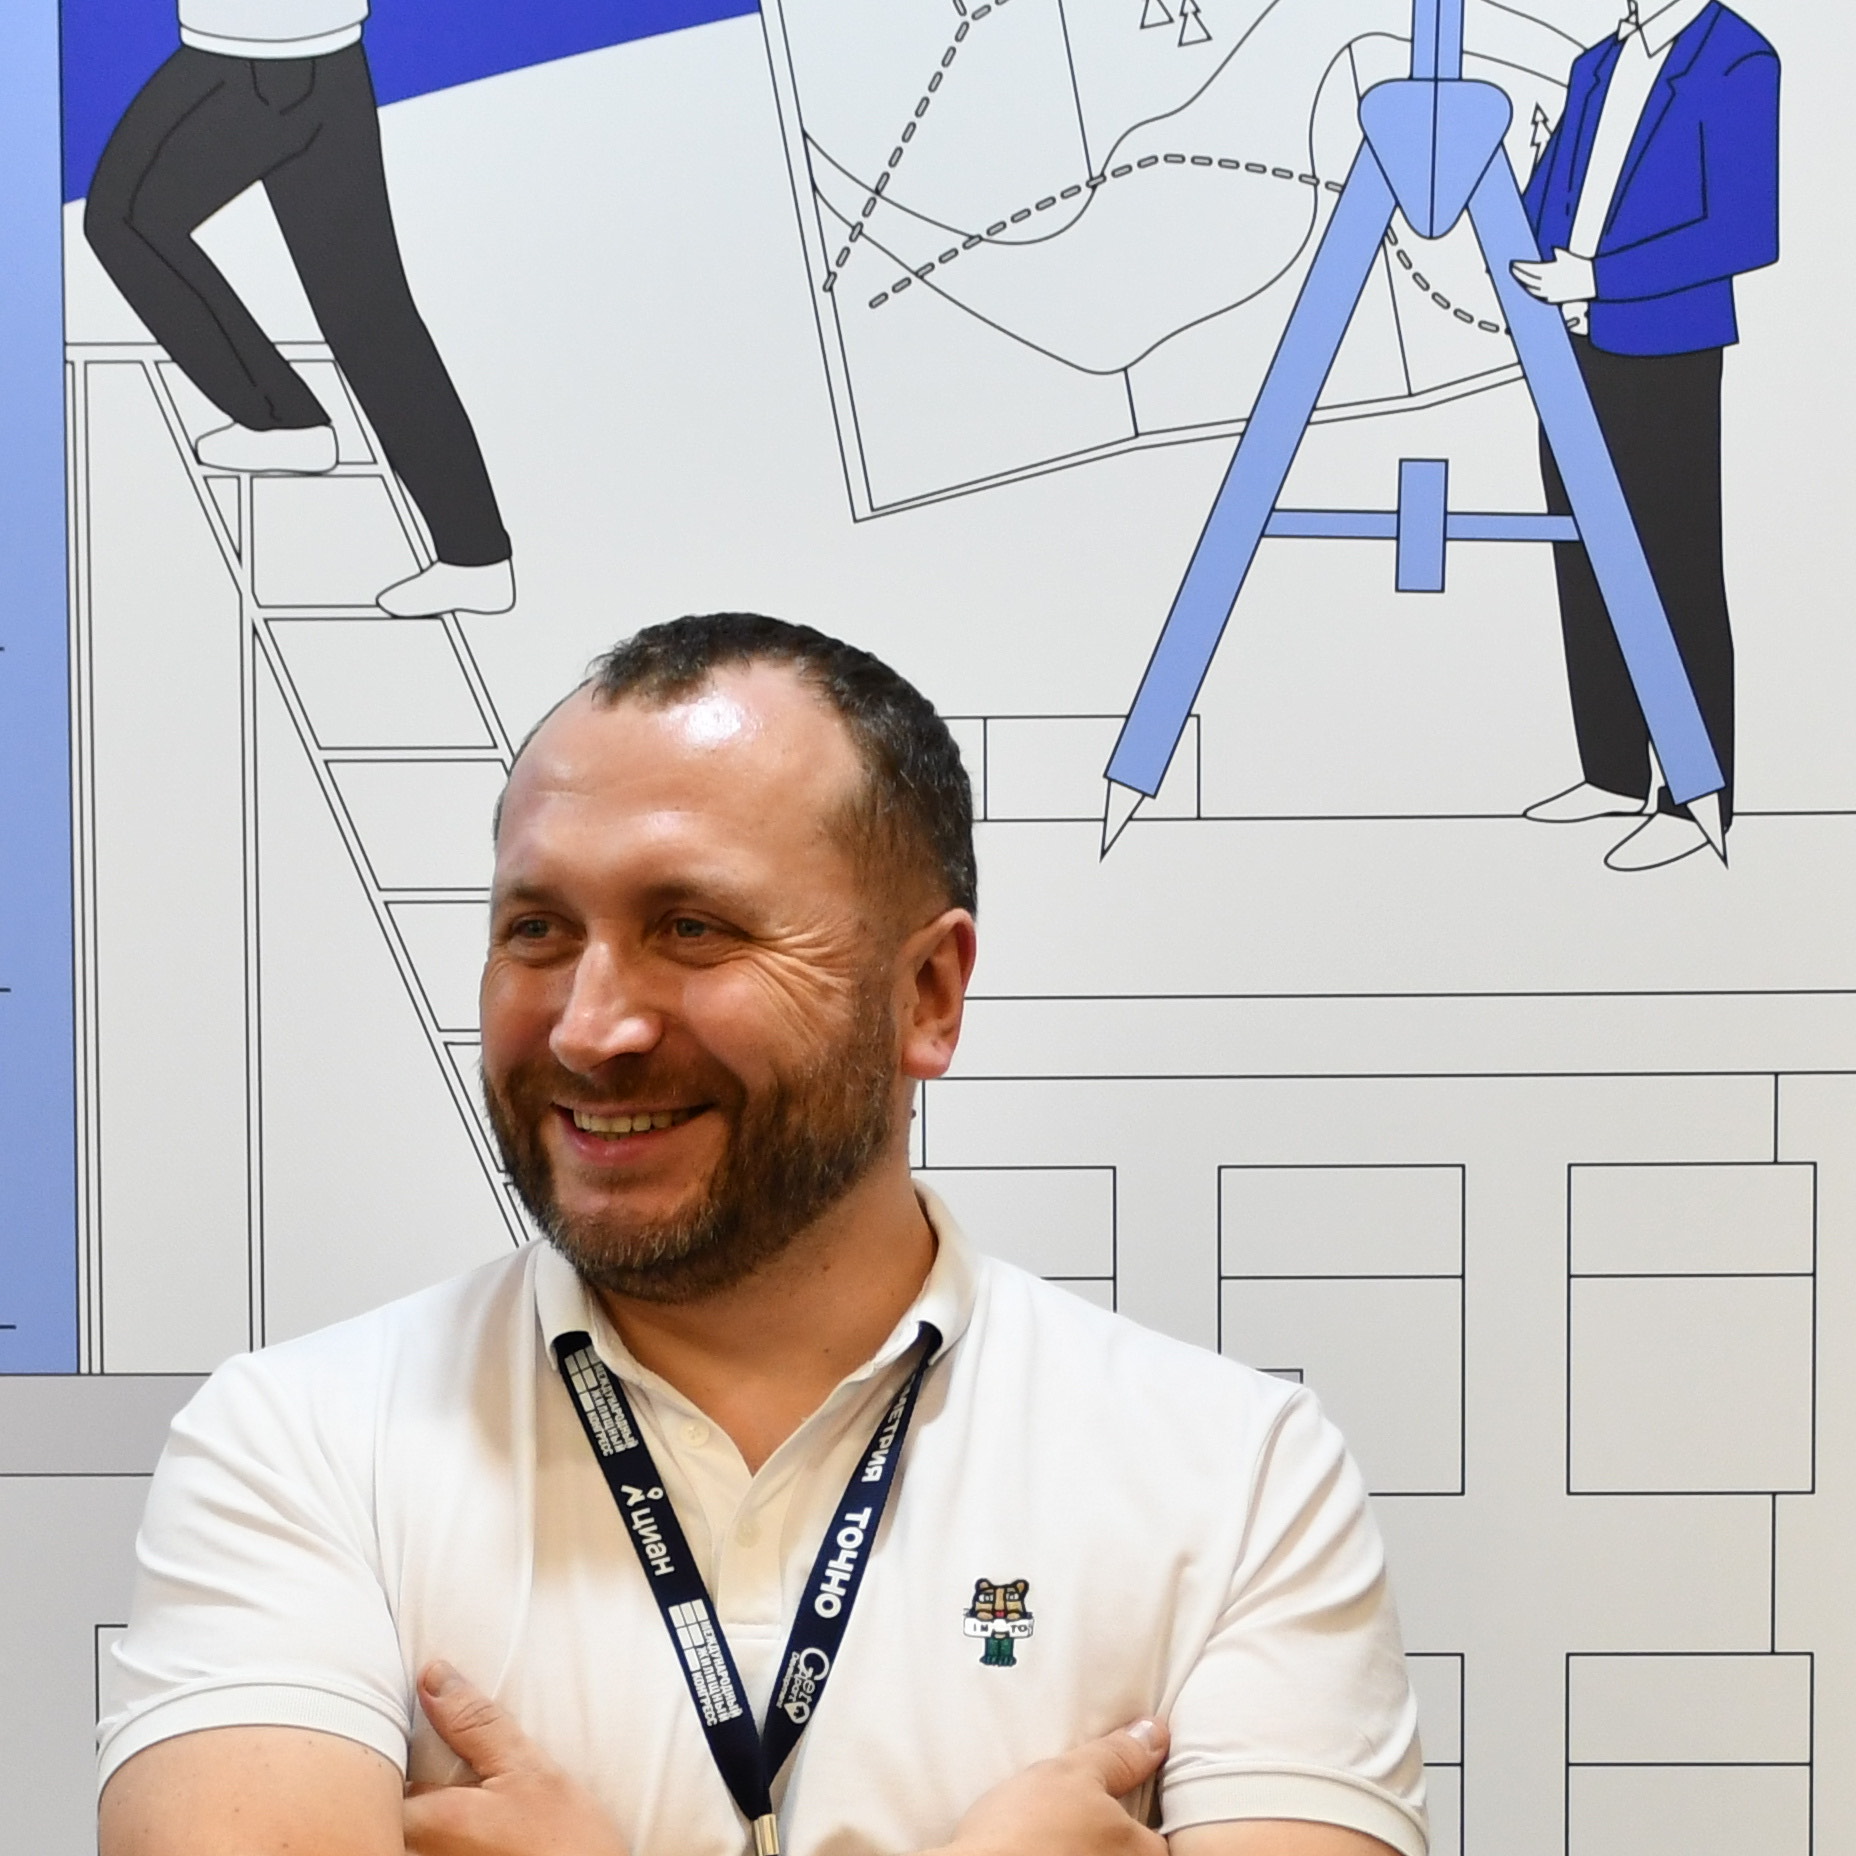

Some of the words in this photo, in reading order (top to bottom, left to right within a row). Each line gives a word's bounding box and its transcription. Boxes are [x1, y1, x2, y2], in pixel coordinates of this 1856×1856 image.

[814, 1507, 873, 1619] ТОЧНО
[691, 1671, 718, 1727] КОНГРЕСС
[695, 1645, 731, 1723] ЖИЛИЩНЫЙ
[700, 1620, 744, 1720] МЕЖДУНАРОДНЫЙ
